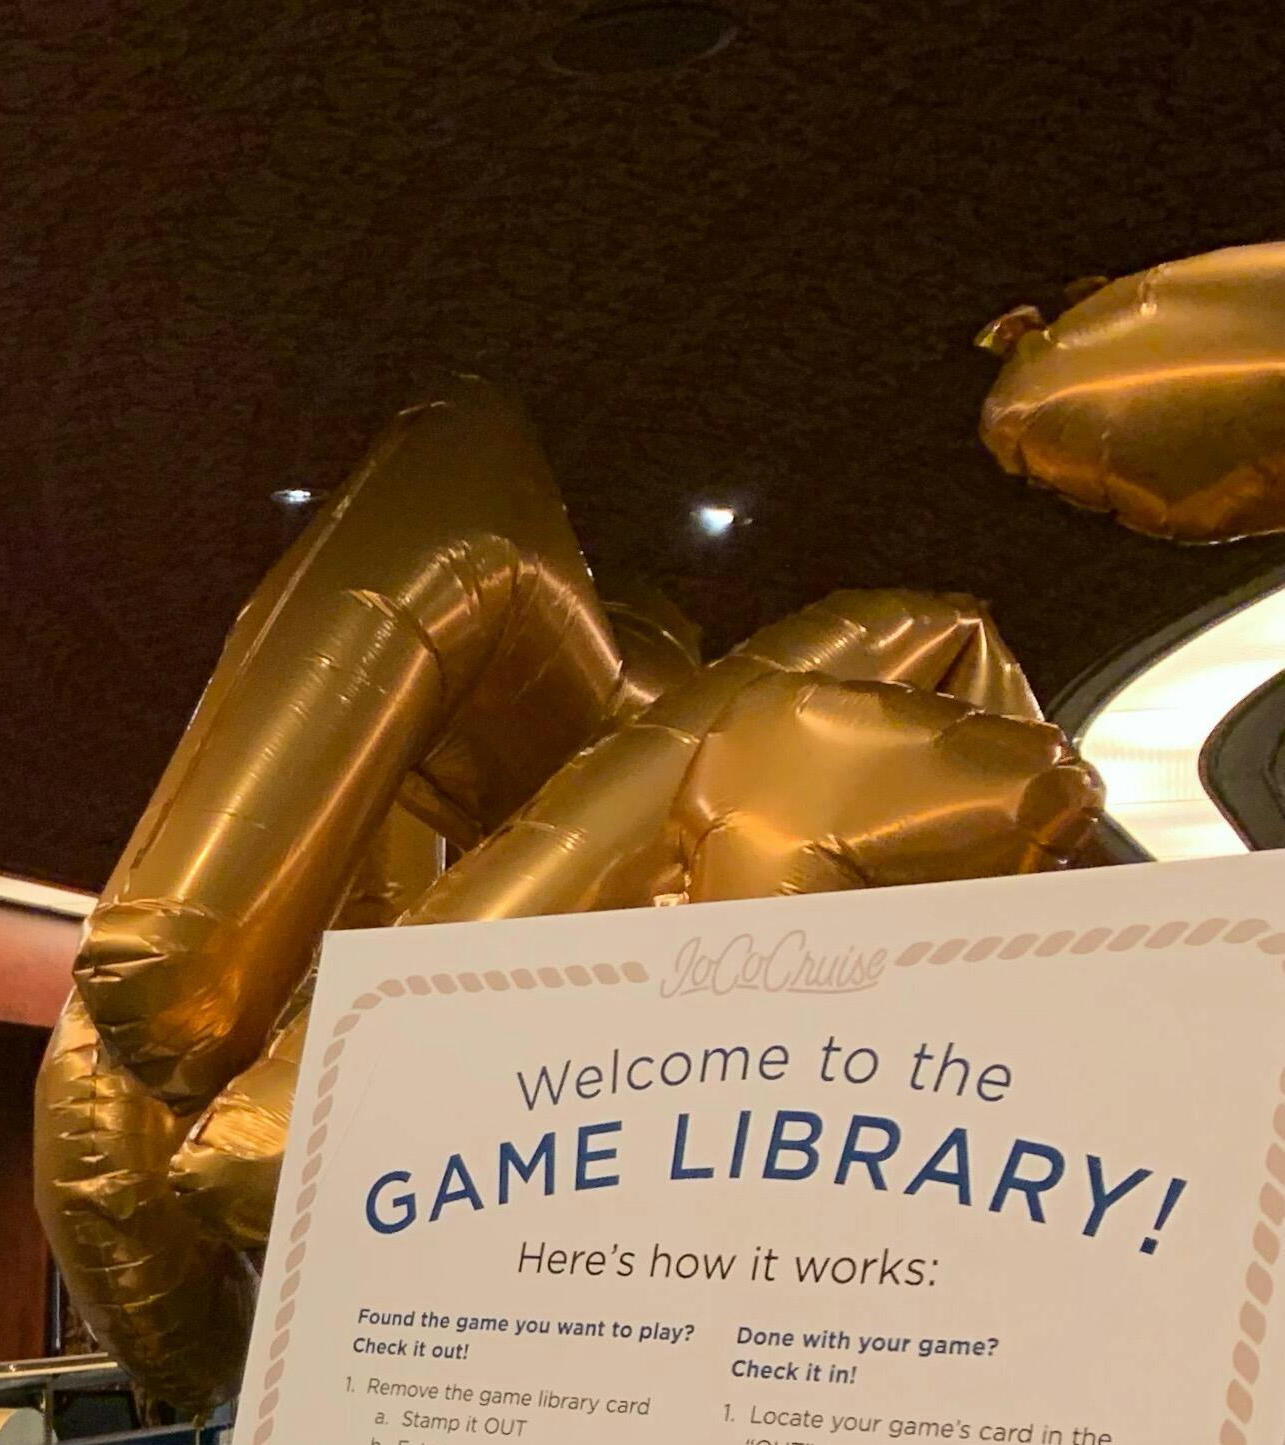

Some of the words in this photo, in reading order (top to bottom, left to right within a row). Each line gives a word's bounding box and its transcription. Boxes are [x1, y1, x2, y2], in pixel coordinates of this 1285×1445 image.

[515, 1035, 791, 1112] Welcome
[820, 1036, 879, 1084] to
[911, 1042, 1014, 1103] the
[365, 1120, 623, 1235] GAME
[670, 1110, 1189, 1256] LIBRARY!
[648, 1242, 737, 1281] how
[750, 1245, 779, 1282] it
[794, 1247, 938, 1286] works:
[356, 1307, 416, 1327] Found
[419, 1310, 451, 1329] the
[454, 1315, 509, 1333] game
[513, 1318, 551, 1336] you
[556, 1319, 606, 1337] want
[611, 1320, 633, 1339] to
[637, 1321, 695, 1345] play?
[735, 1325, 795, 1347] Done
[801, 1329, 851, 1350] with
[856, 1335, 912, 1355] your
[917, 1336, 1000, 1358] game?
[351, 1336, 408, 1356] Check
[412, 1339, 426, 1358] it
[430, 1342, 470, 1360] out!
[730, 1358, 800, 1381] Check
[804, 1361, 822, 1383] it
[827, 1363, 857, 1384] in!
[723, 1402, 734, 1422] 1.
[749, 1404, 824, 1429] Locate
[828, 1414, 883, 1434] your
[978, 1422, 1034, 1444] card
[1040, 1424, 1063, 1445] in
